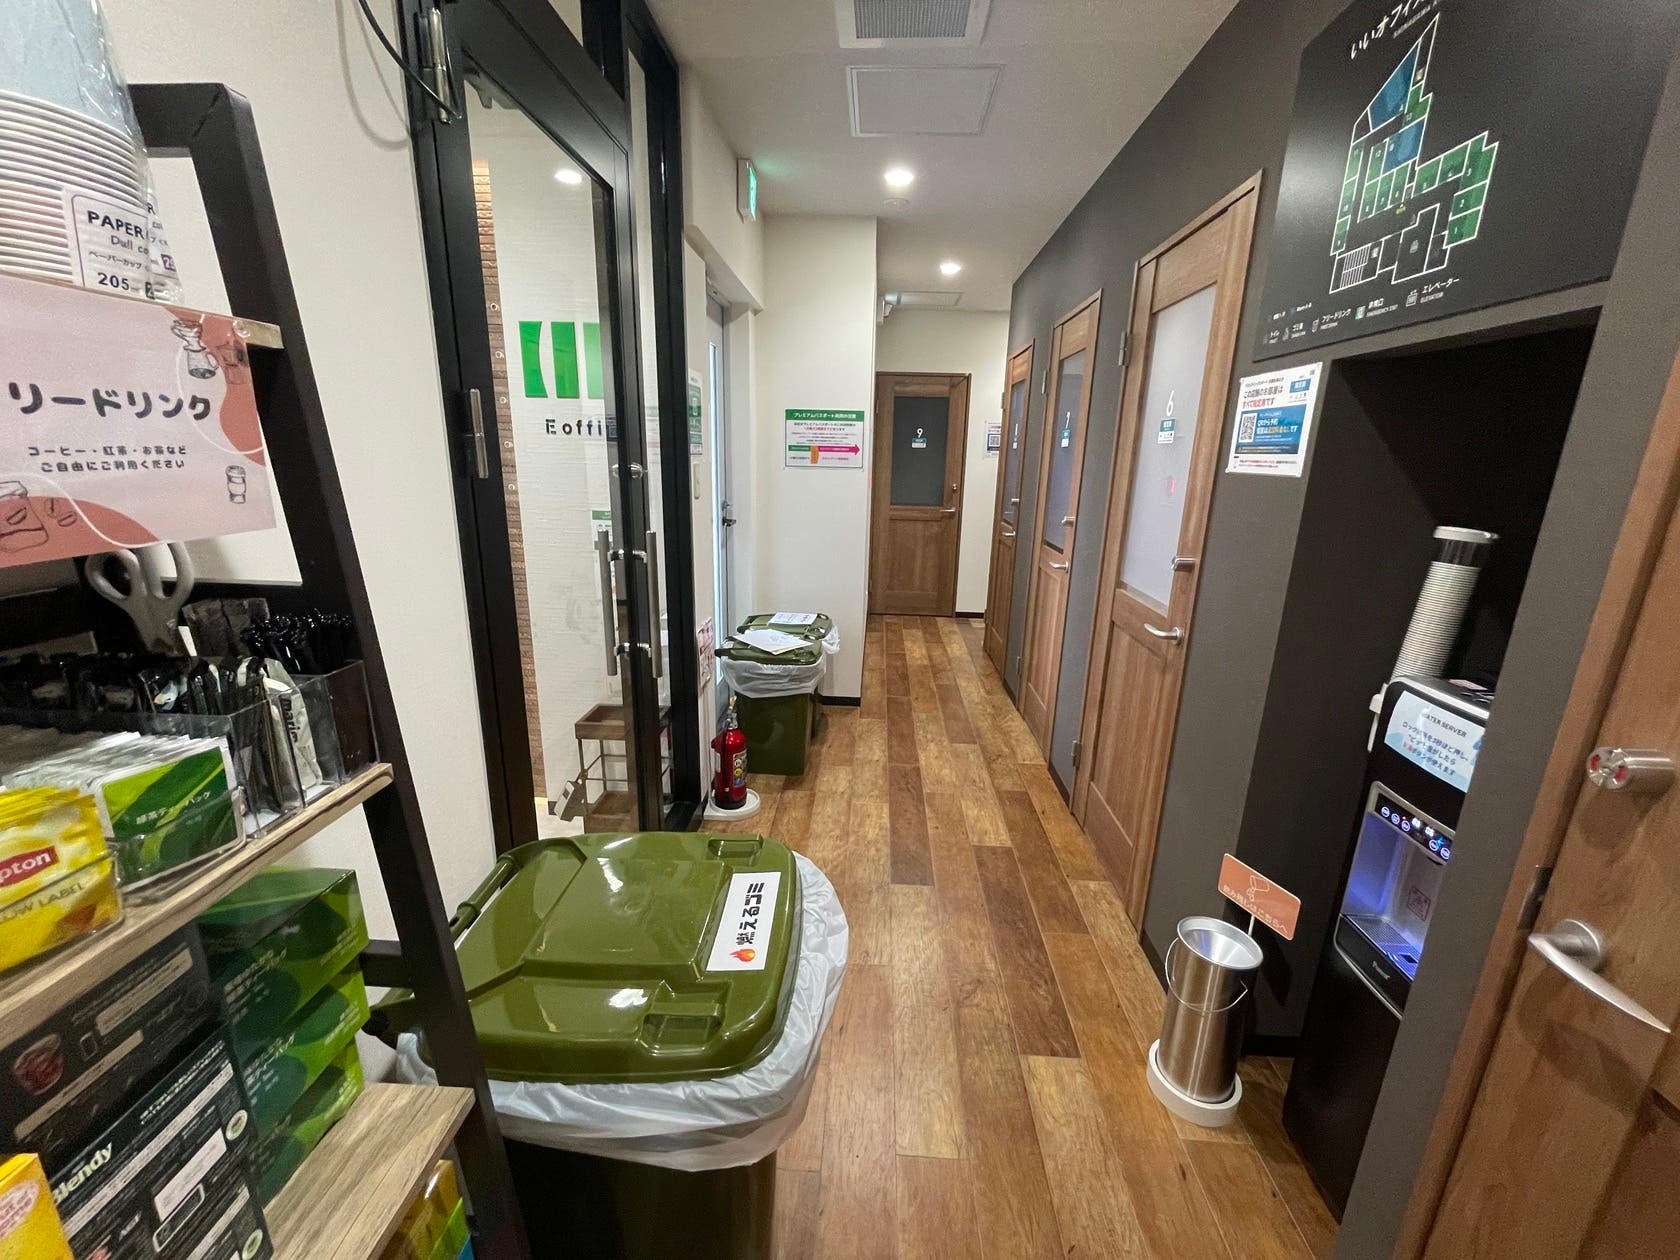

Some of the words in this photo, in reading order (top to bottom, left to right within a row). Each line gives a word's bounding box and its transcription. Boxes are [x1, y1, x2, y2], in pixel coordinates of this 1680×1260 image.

[87, 210, 145, 240] PAPER
[1166, 390, 1175, 417] 6
[916, 428, 924, 438] 9
[41, 461, 185, 473] ご自由にご利用ください
[1442, 721, 1467, 737] SERVER
[736, 882, 765, 946] 燃えるゴミ
